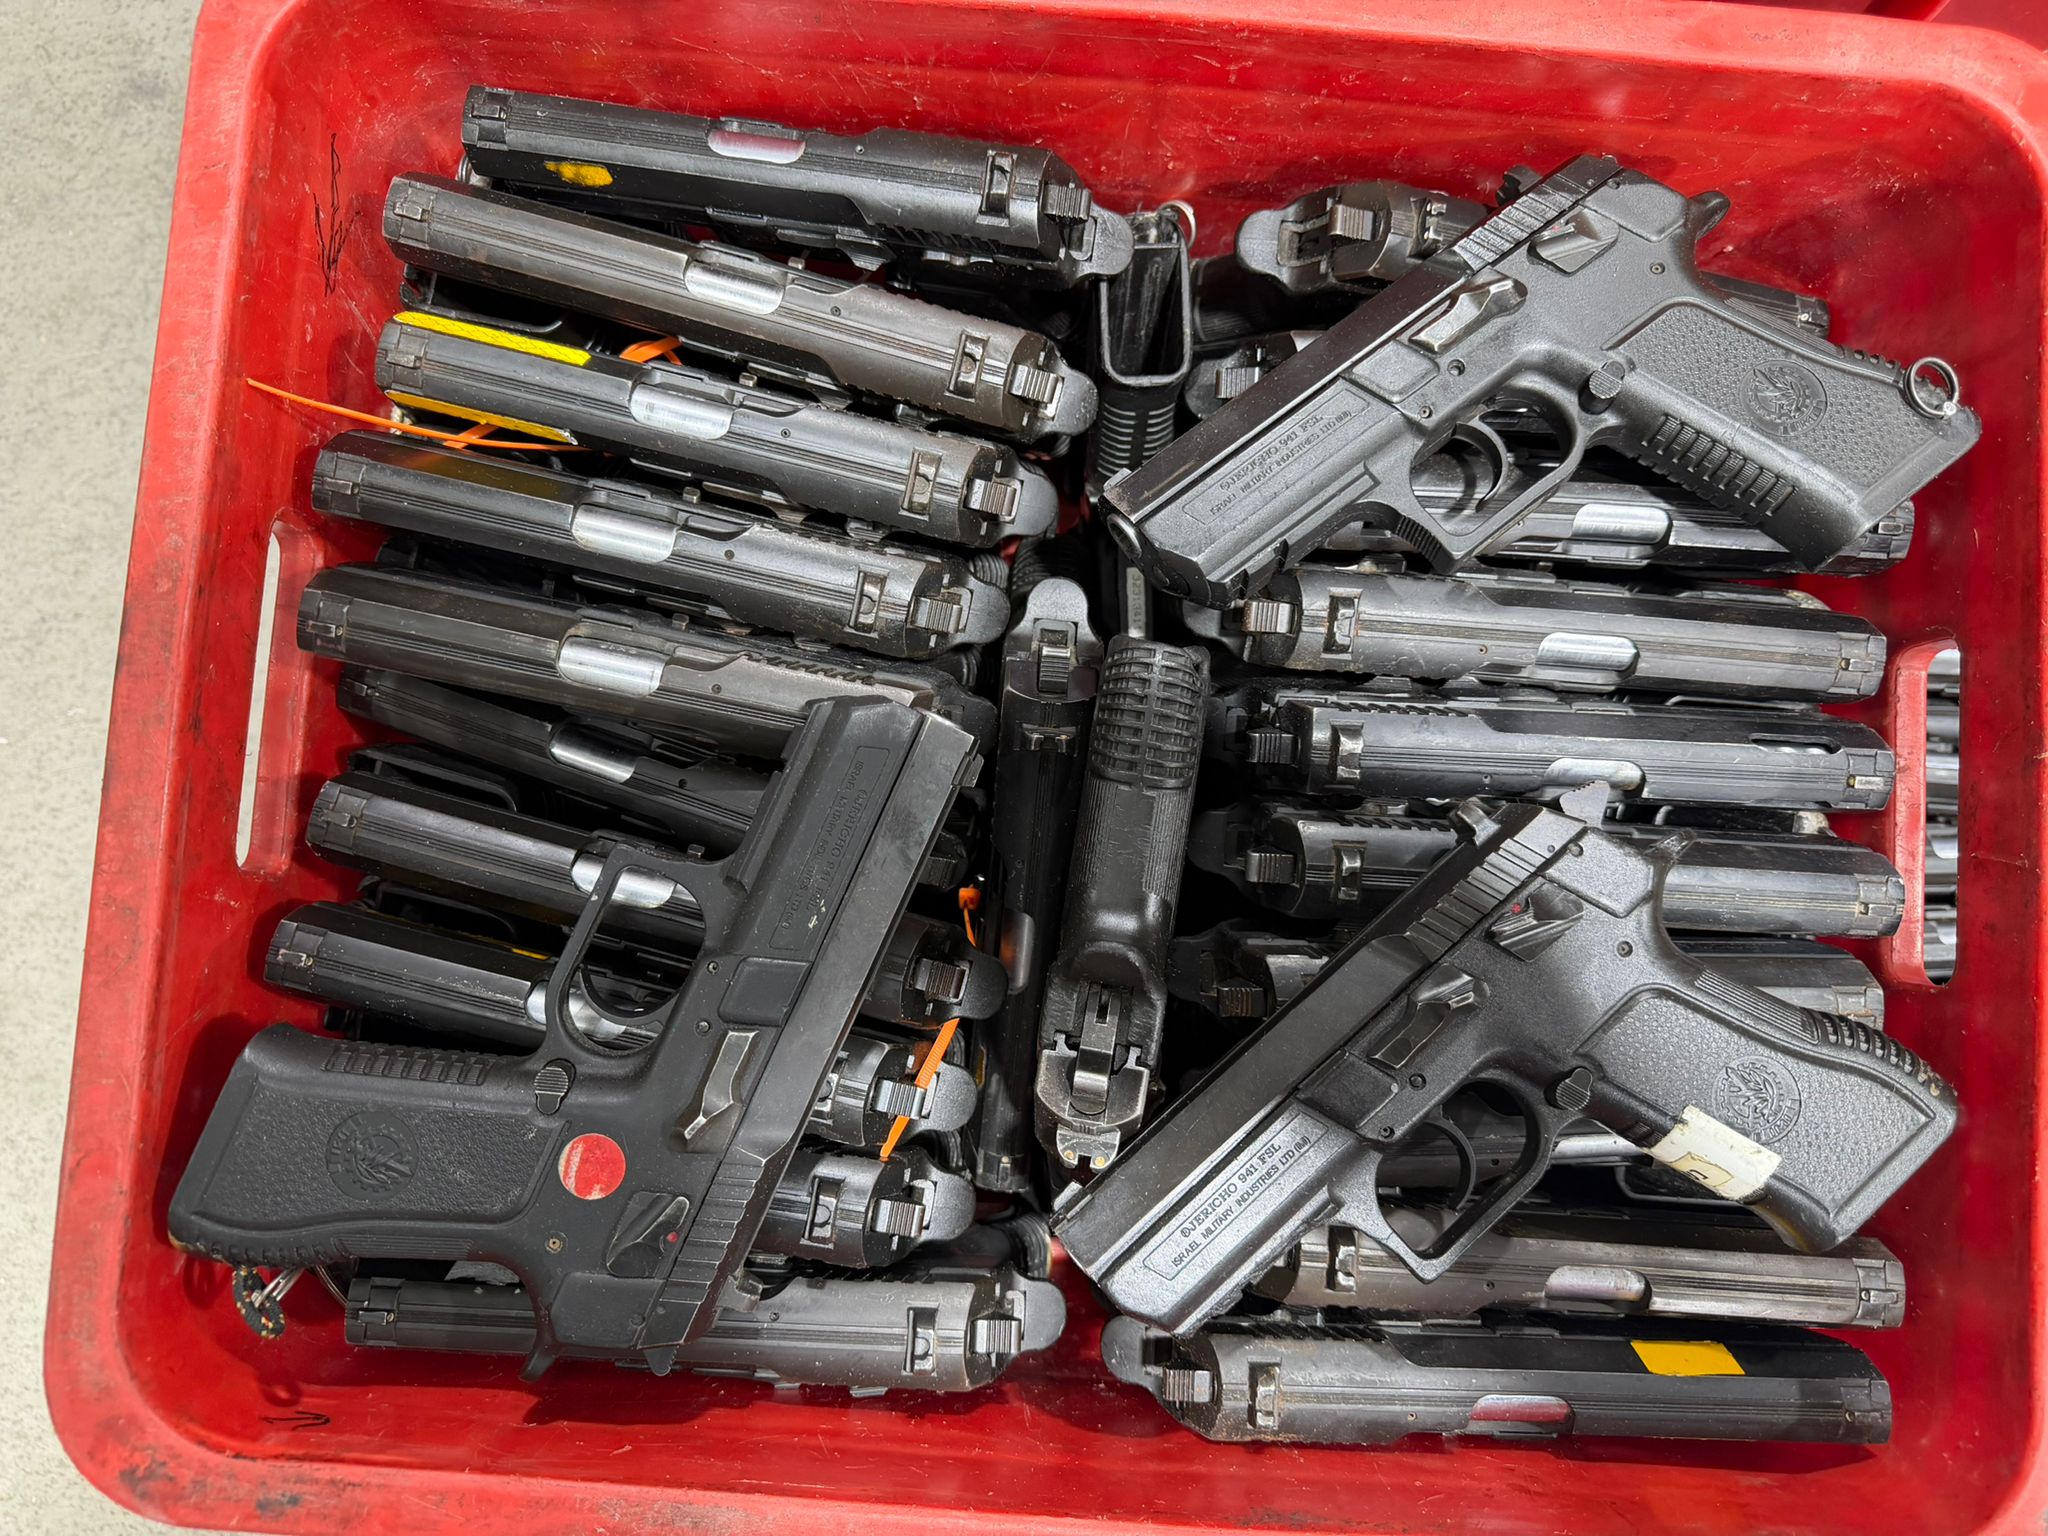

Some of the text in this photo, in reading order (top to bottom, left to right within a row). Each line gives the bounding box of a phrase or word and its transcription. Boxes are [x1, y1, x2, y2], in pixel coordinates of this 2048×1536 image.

[1277, 429, 1299, 448] 941
[1298, 411, 1323, 433] FSL
[1239, 465, 1274, 493] MILITARY
[1236, 1162, 1258, 1184] 941
[1256, 1140, 1282, 1165] FSL
[1170, 1237, 1202, 1268] ISRAEL
[1199, 1205, 1236, 1240] MILITARY
[1234, 1163, 1280, 1207] INDUSTRIES
[1277, 1148, 1295, 1166] LTD
